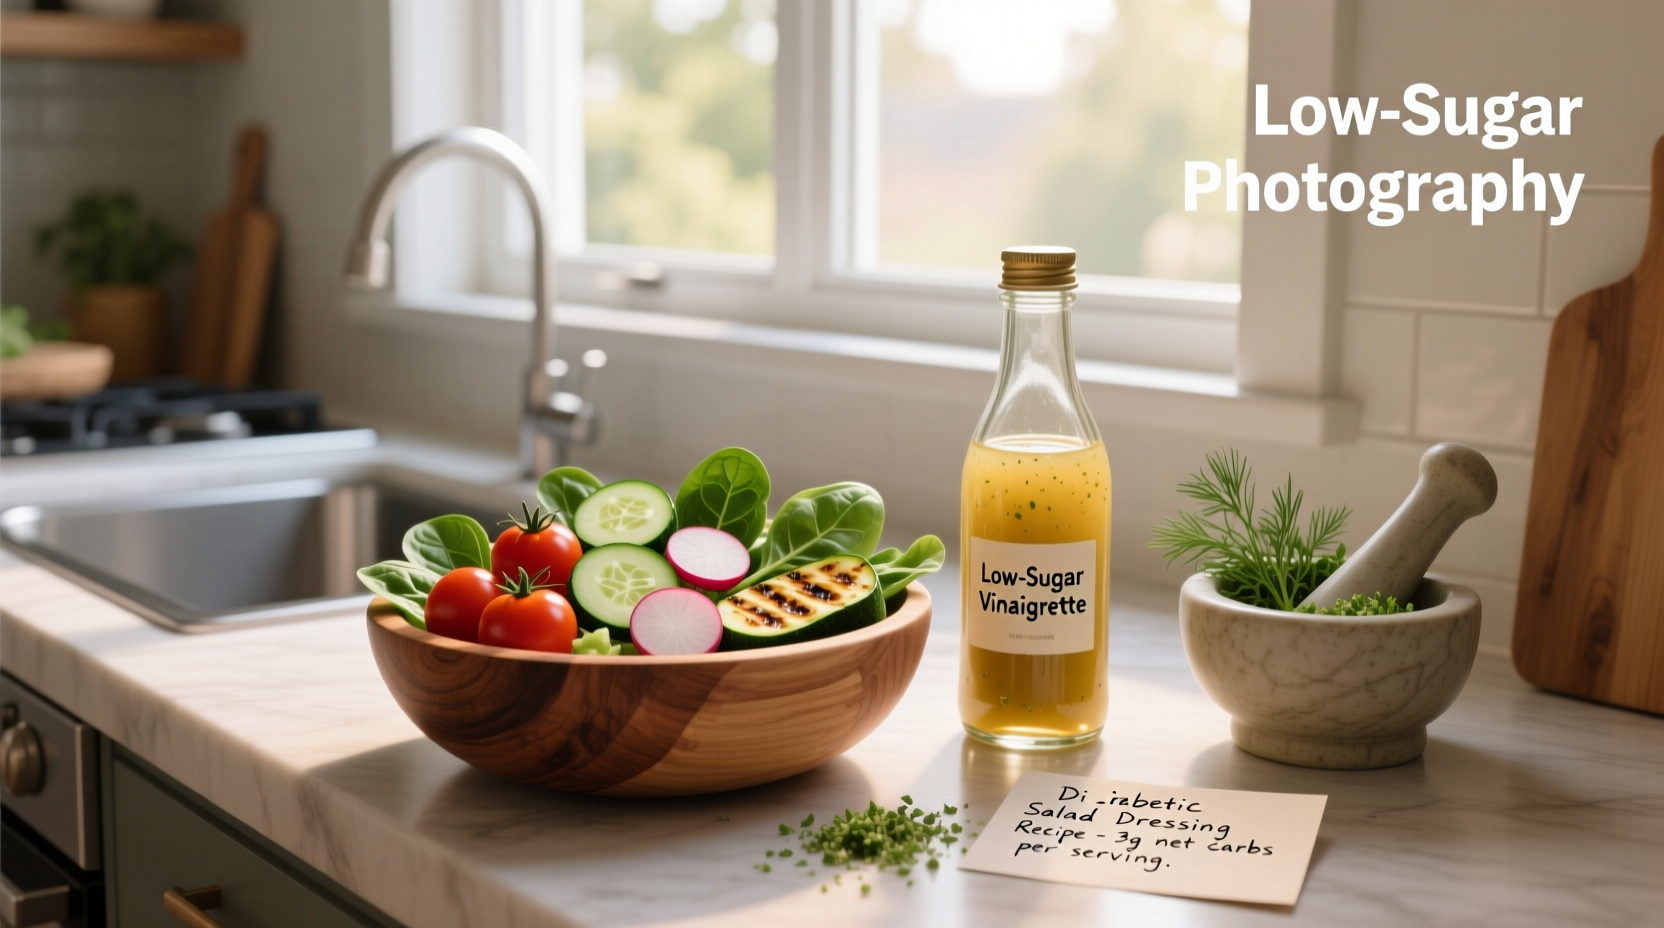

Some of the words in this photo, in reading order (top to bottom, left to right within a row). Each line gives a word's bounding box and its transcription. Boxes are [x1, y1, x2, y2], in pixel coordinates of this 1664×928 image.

[981, 562, 1085, 593] Low-Sugar
[979, 590, 1087, 622] Vinaigrette
[1014, 819, 1086, 845] Recipe
[1114, 831, 1142, 853] 3g
[1155, 837, 1196, 849] net
[1207, 838, 1274, 856] carbs
[1023, 802, 1099, 823] Salad
[1116, 811, 1231, 841] Dressing
[1014, 842, 1058, 857] per
[1070, 847, 1171, 873] serving.
